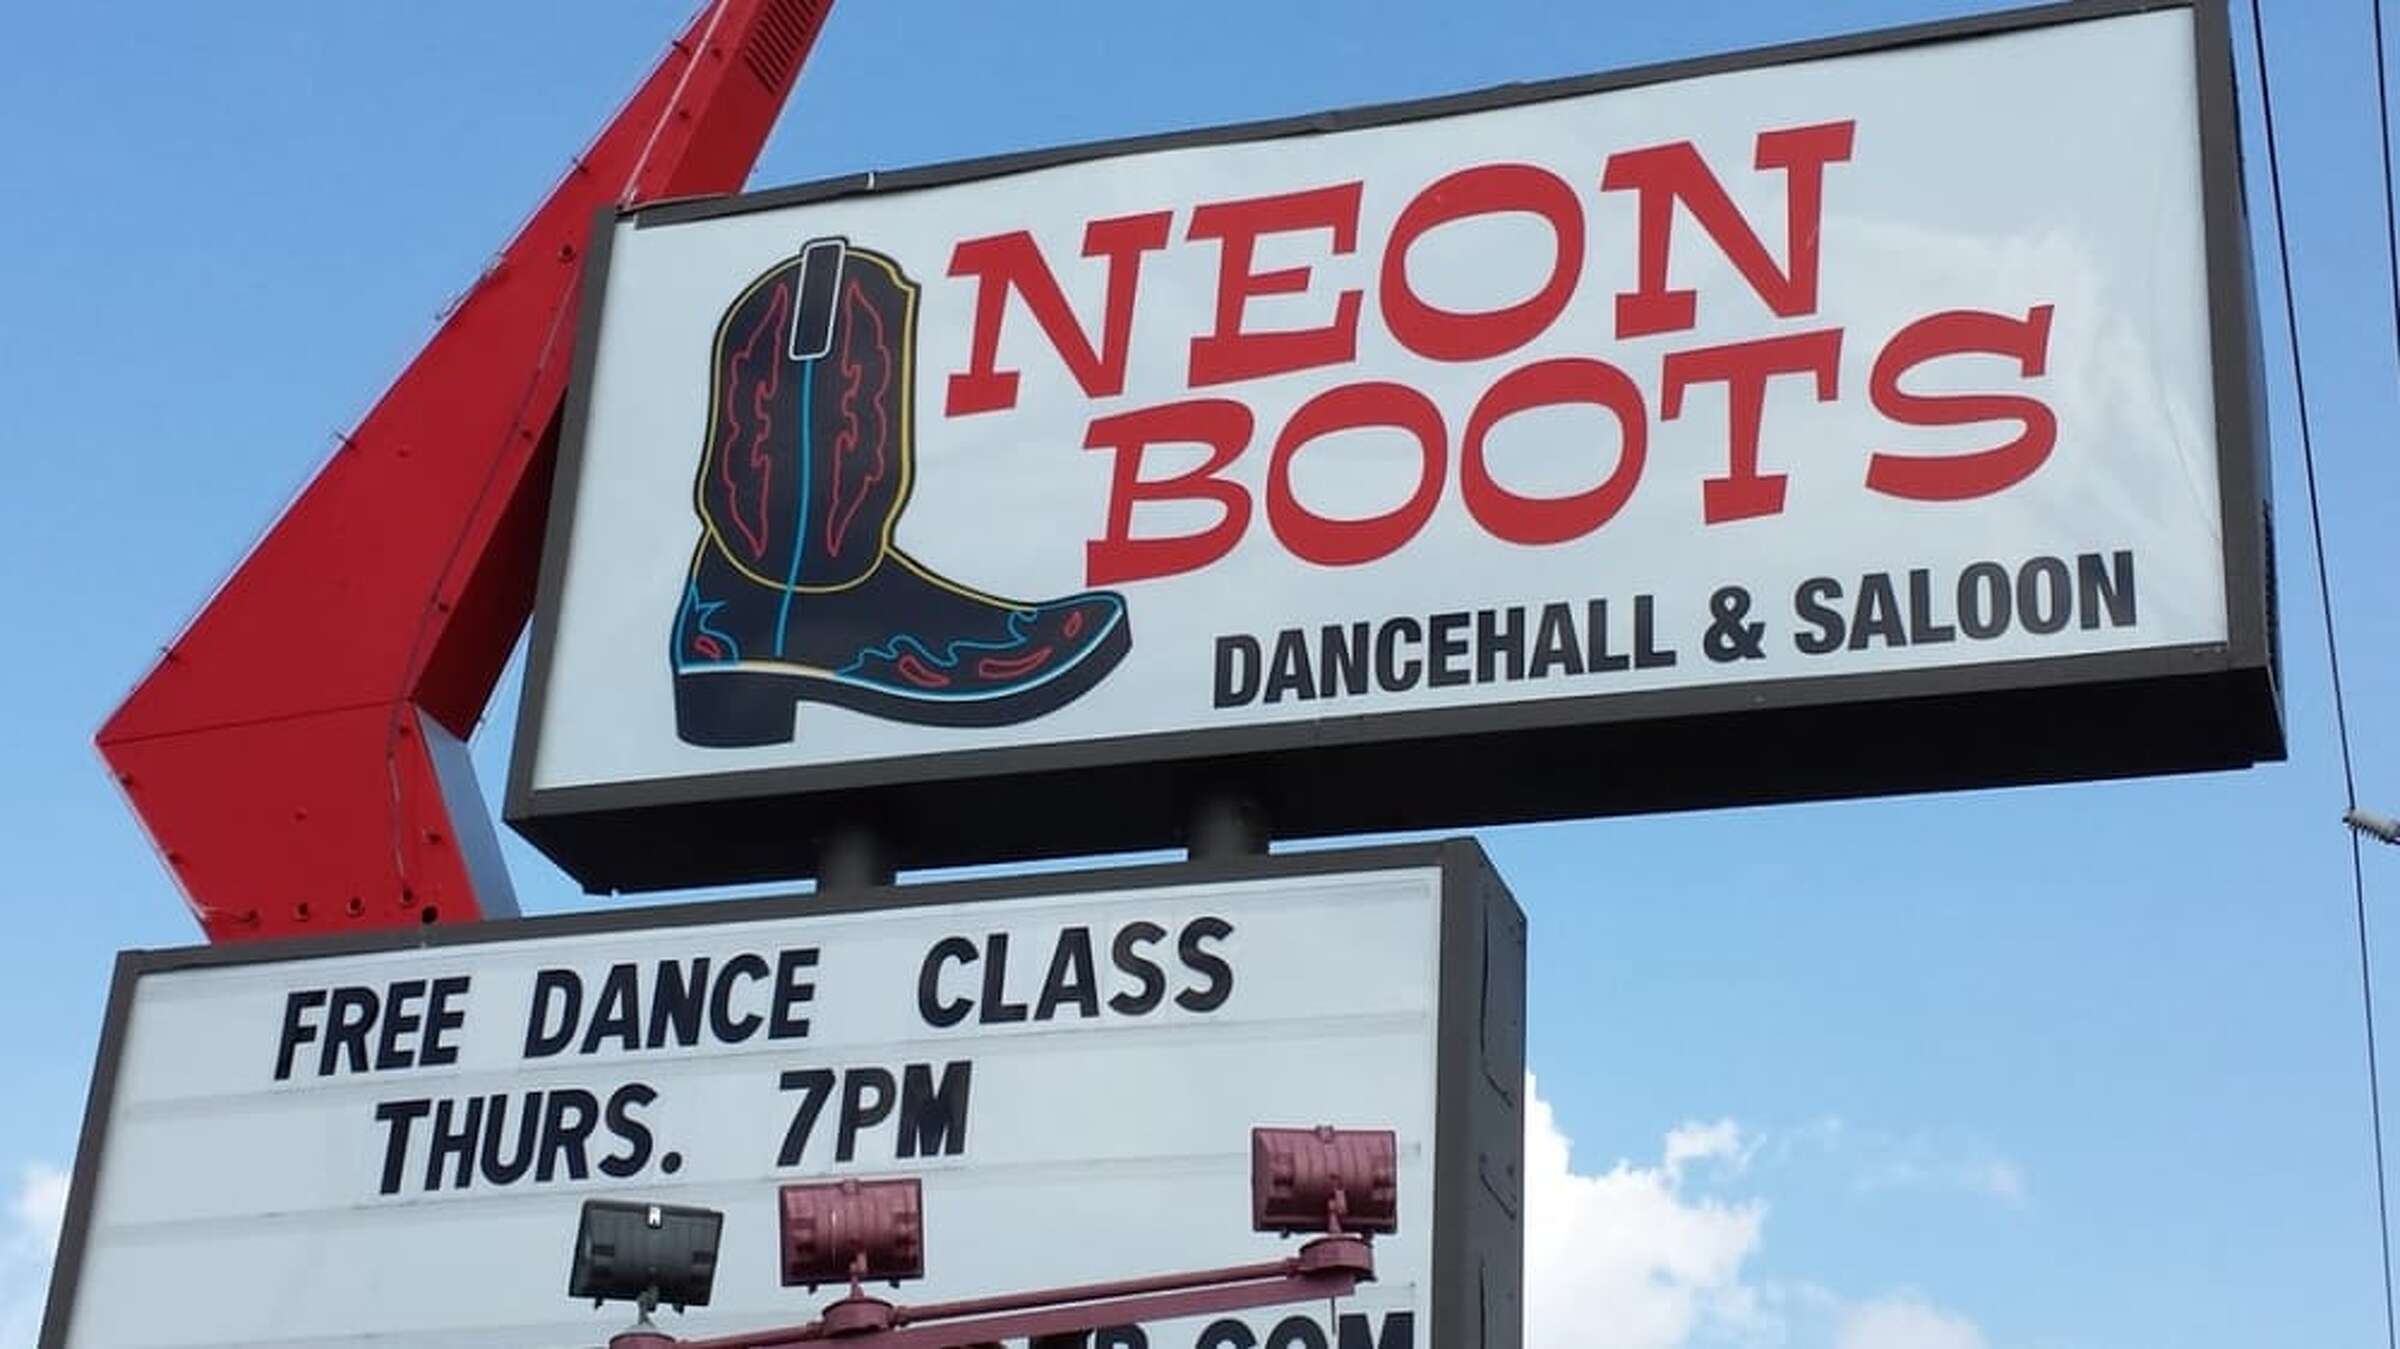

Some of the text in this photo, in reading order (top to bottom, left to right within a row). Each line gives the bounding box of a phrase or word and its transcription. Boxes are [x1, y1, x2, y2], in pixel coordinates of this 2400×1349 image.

[945, 119, 1856, 418] NEON
[1085, 304, 2058, 588] BOOTS
[1213, 550, 2137, 710] DANCEHALL & SALOON
[273, 916, 1234, 1081] FREE DANCE CLASS
[375, 1060, 973, 1195] THURS. 7PM
